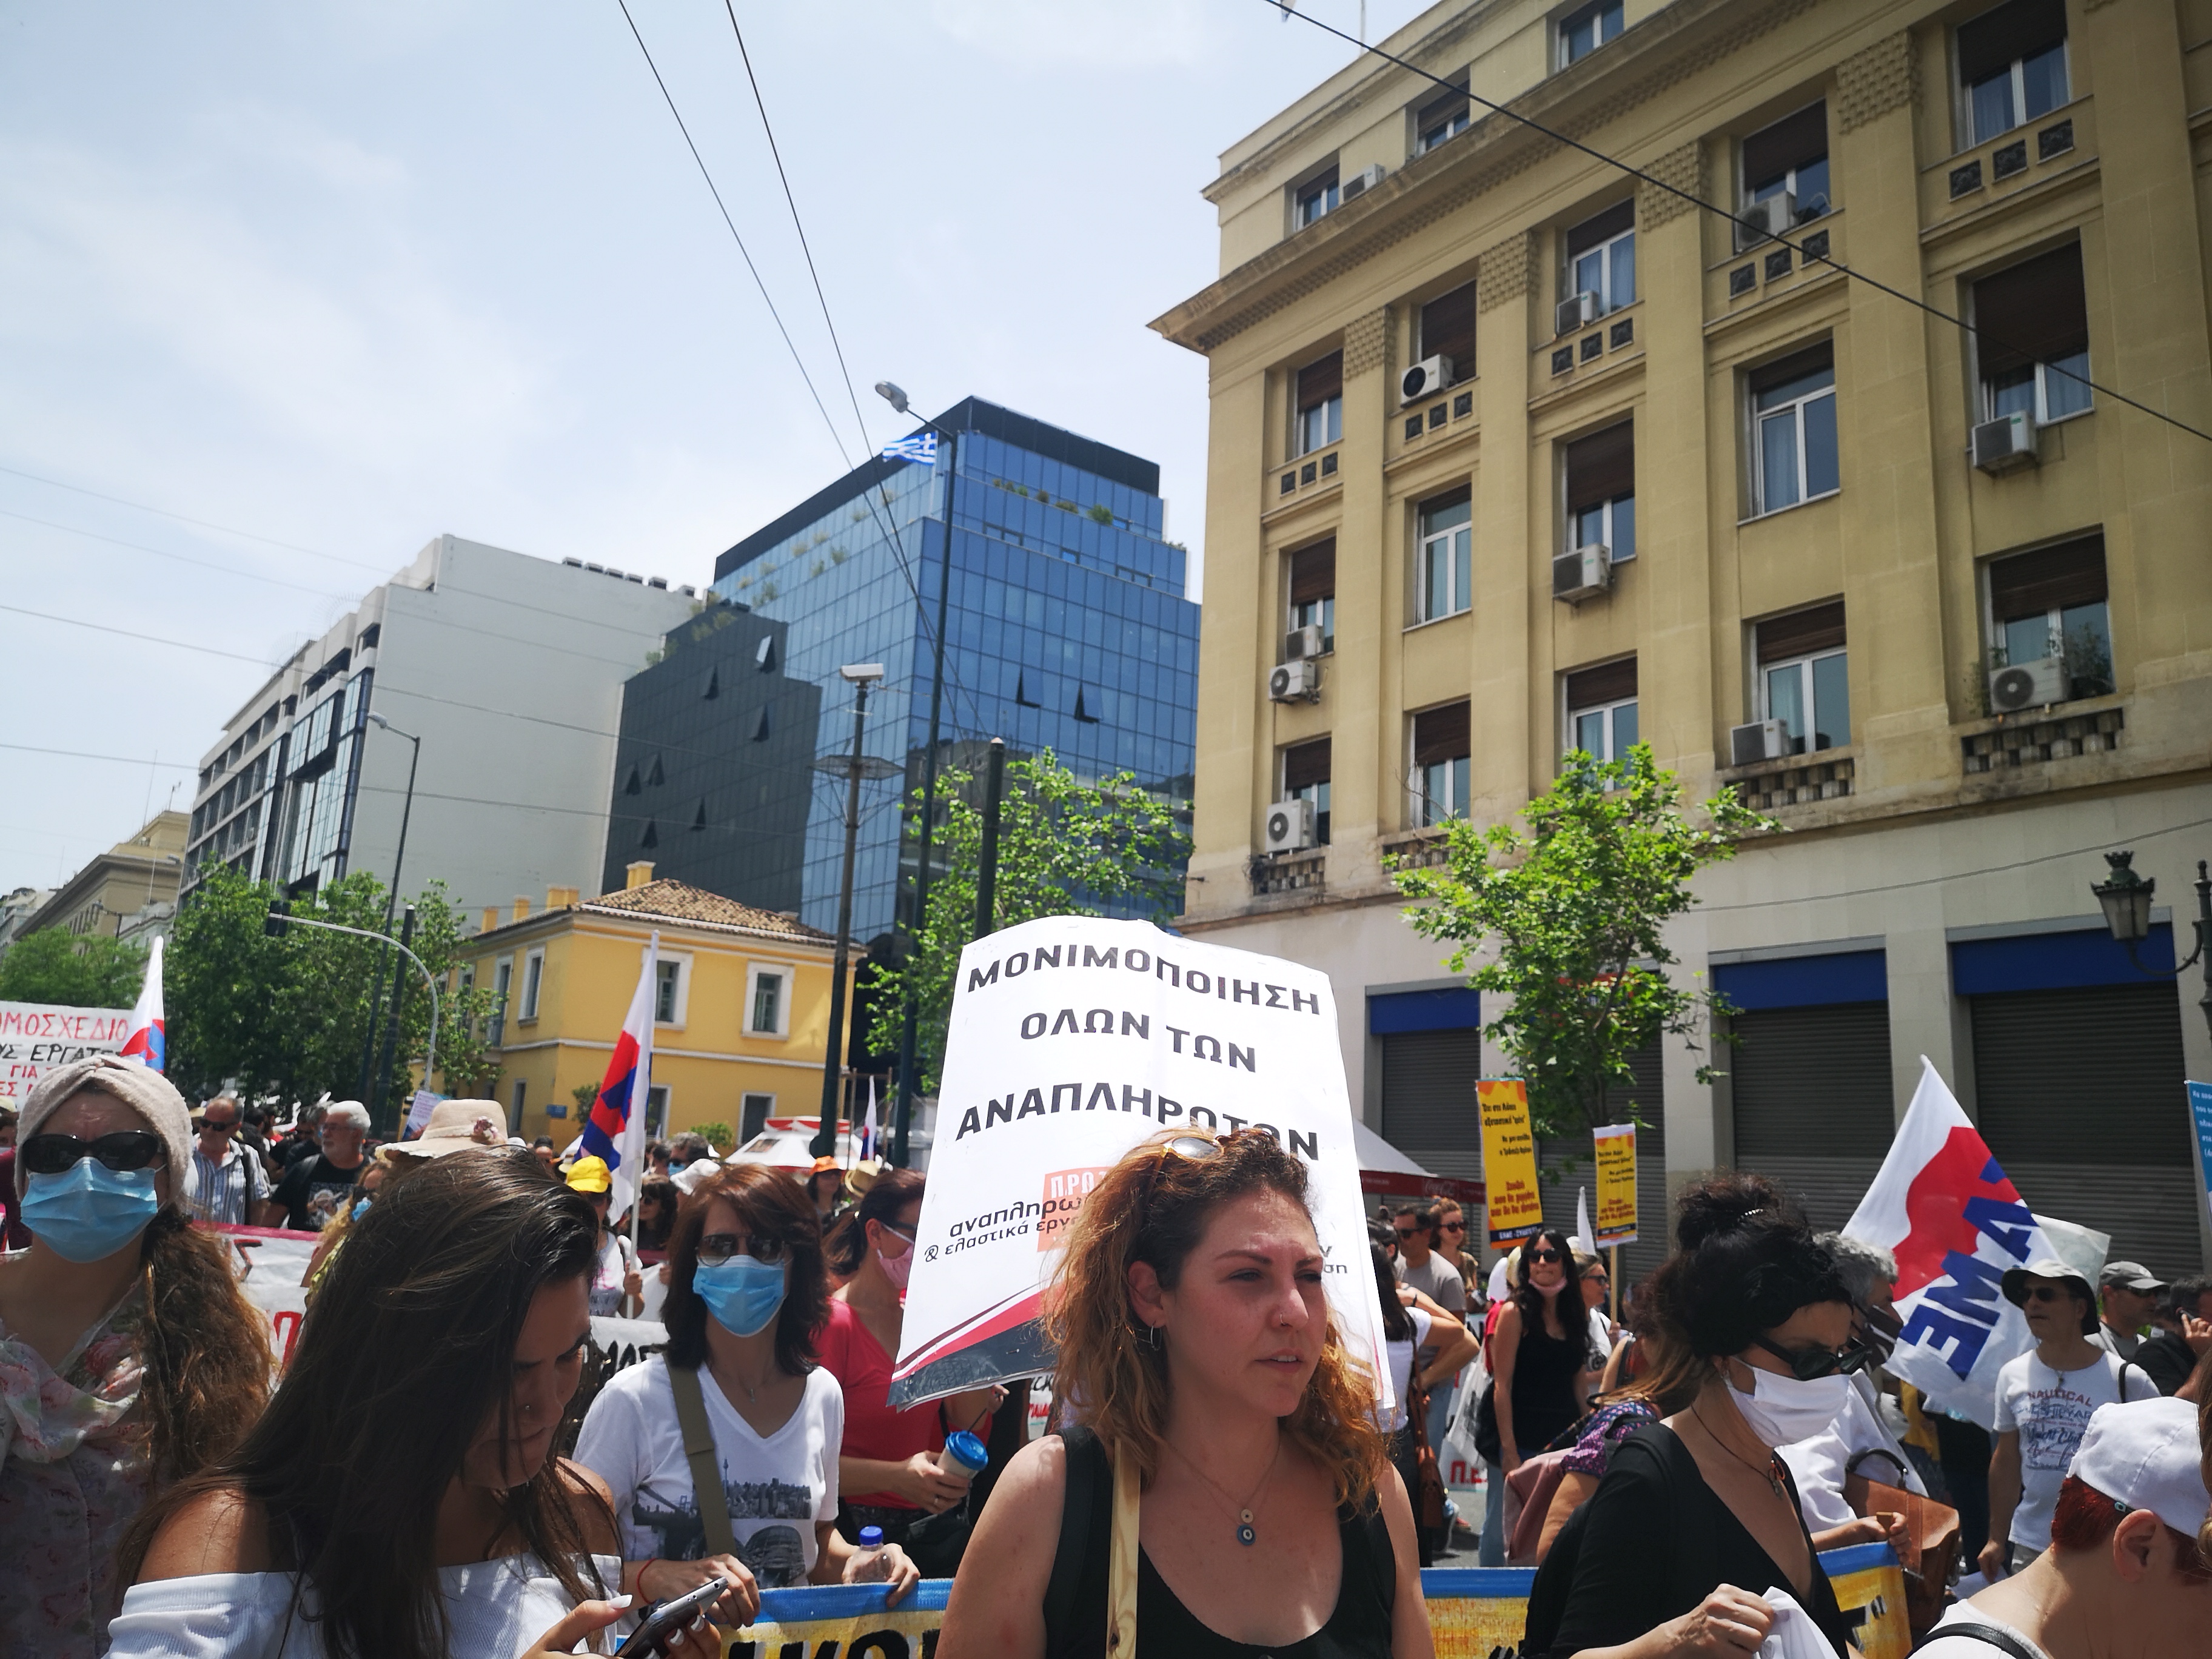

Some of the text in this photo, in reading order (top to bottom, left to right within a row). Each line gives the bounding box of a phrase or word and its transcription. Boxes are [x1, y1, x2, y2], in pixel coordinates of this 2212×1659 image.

[968, 943, 1321, 1016] ΜΟΝΙΜΟΠΟΙΗΣΗ
[0, 1011, 129, 1041] ΜΟΣΧΕΔΙΟ
[1020, 1008, 1257, 1074] ΟΛΩΝ ΤΩΝ
[10, 1065, 38, 1079] ΓΙΑ
[944, 1219, 1029, 1255] ελαστικά
[2027, 1389, 2093, 1407] NAUTICAL
